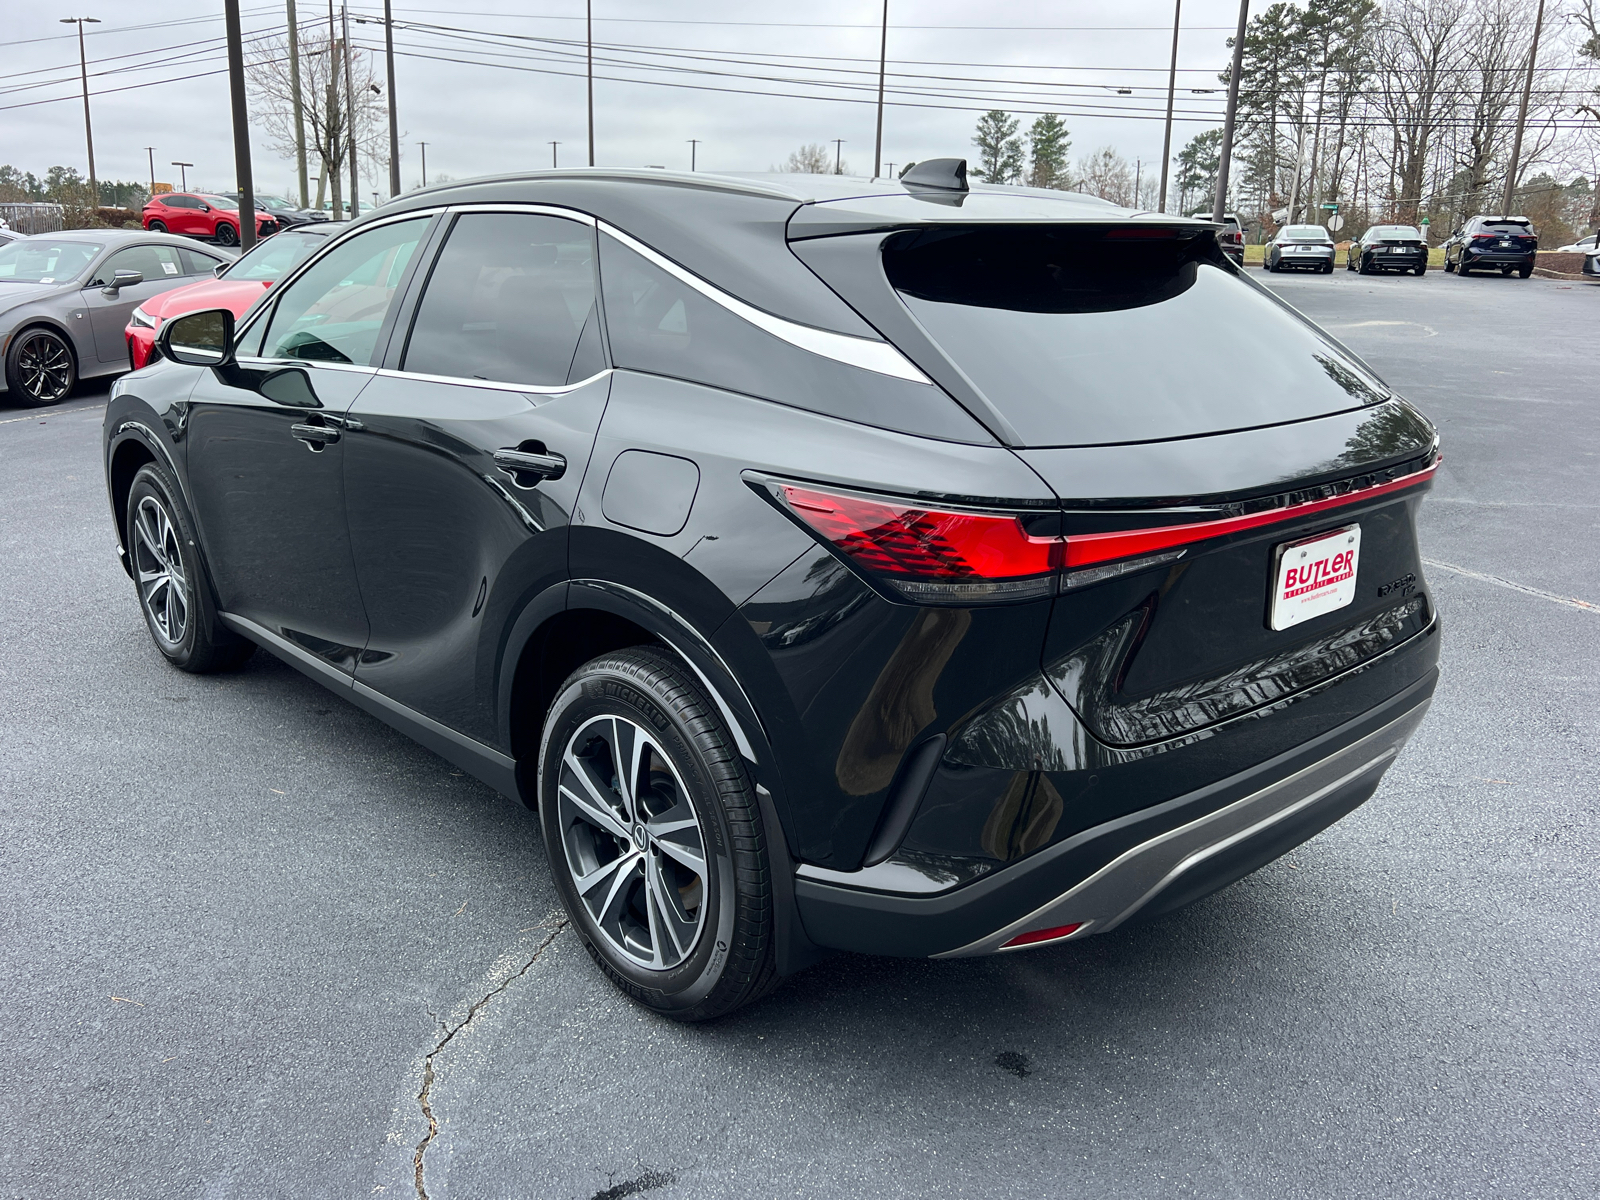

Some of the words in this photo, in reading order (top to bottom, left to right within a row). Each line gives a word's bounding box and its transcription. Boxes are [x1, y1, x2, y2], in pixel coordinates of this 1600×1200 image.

[605, 683, 667, 730] MICHELIN
[673, 735, 703, 787] PRIMACY
[708, 811, 723, 847] SEASON
